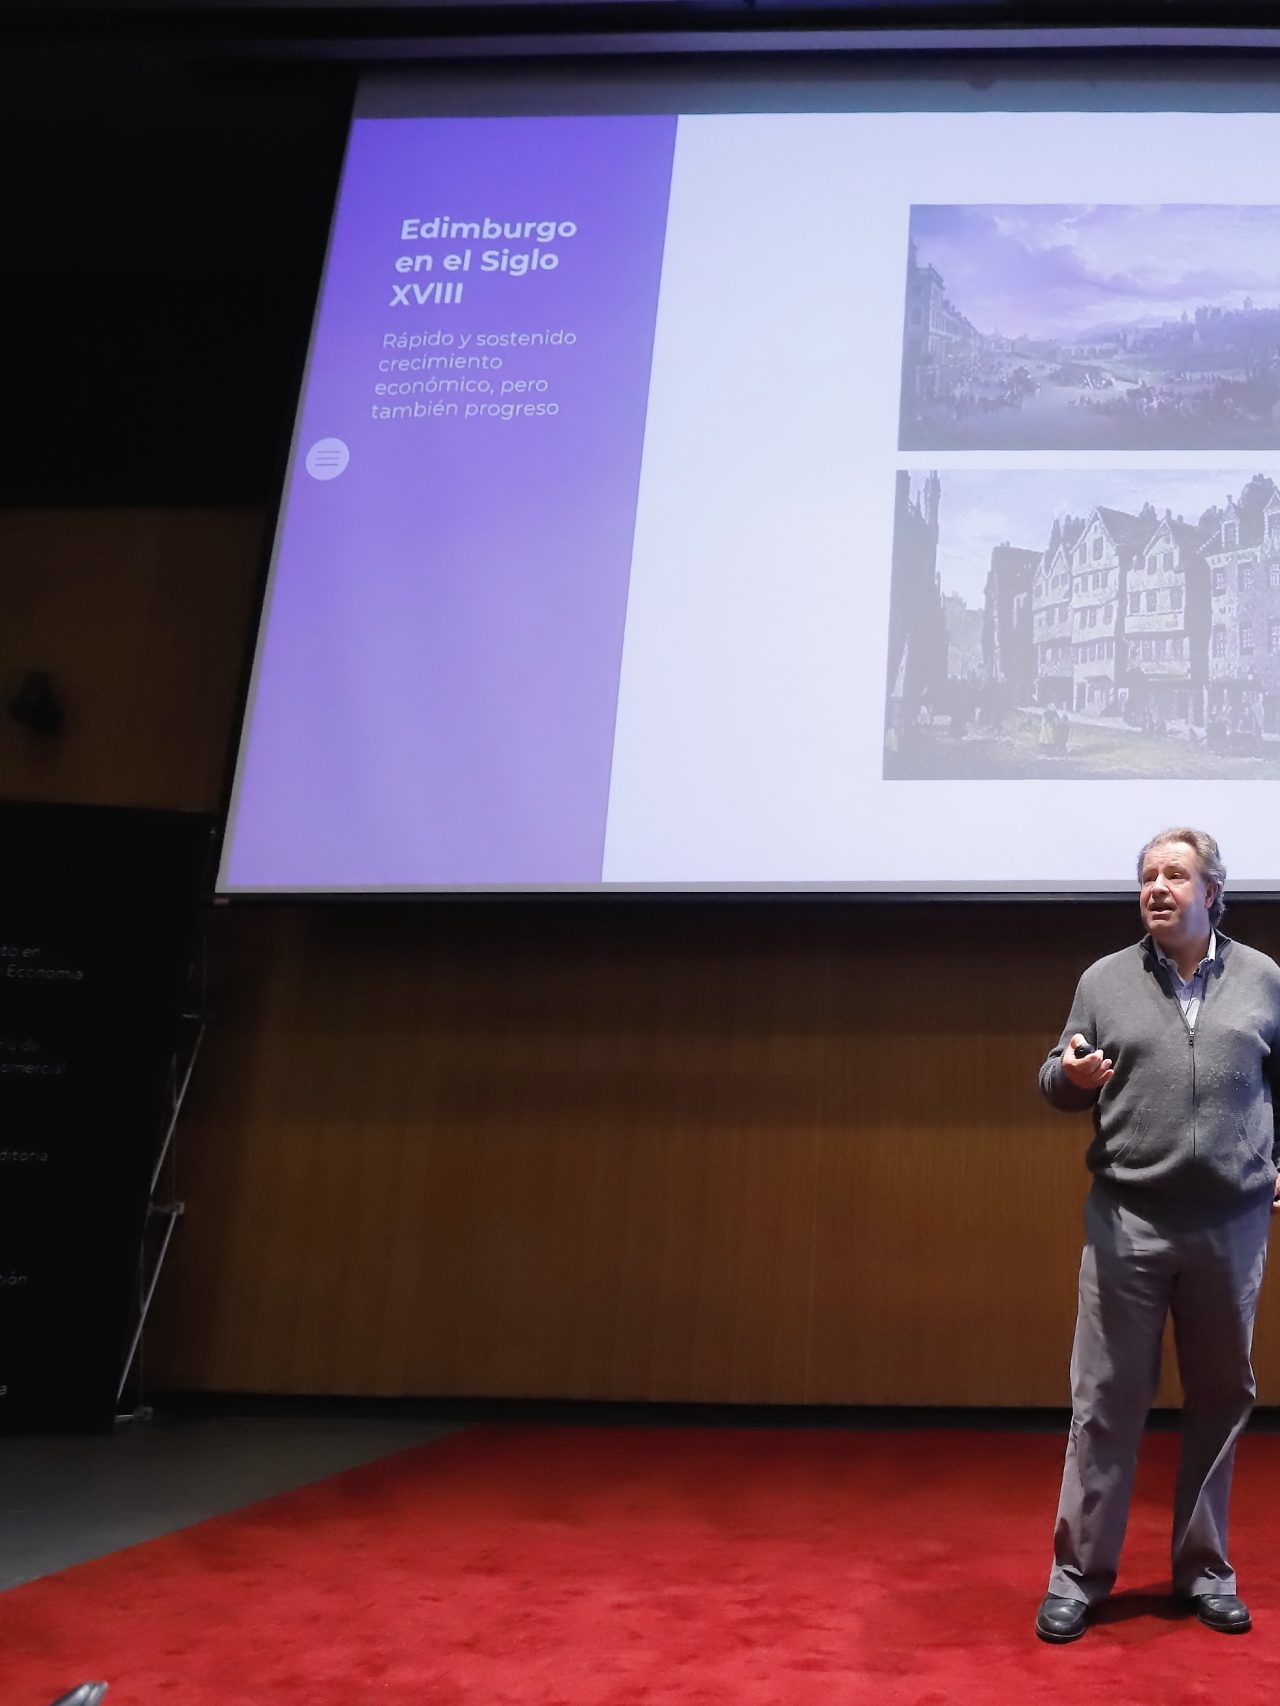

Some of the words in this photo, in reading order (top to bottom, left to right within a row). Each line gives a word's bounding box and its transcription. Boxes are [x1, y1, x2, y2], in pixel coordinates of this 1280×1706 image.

[401, 216, 578, 242] Edimburgo
[395, 253, 433, 273] en
[443, 249, 471, 272] el
[480, 248, 559, 276] Siglo
[389, 282, 463, 306] XVIII
[383, 330, 454, 351] Rápido
[457, 333, 472, 349] y
[476, 329, 577, 347] sostenido
[378, 352, 503, 372] crecimiento
[374, 376, 495, 396] económico,
[500, 378, 549, 396] pero
[371, 399, 458, 420] también
[464, 401, 559, 420] progreso
[22, 948, 41, 957] en
